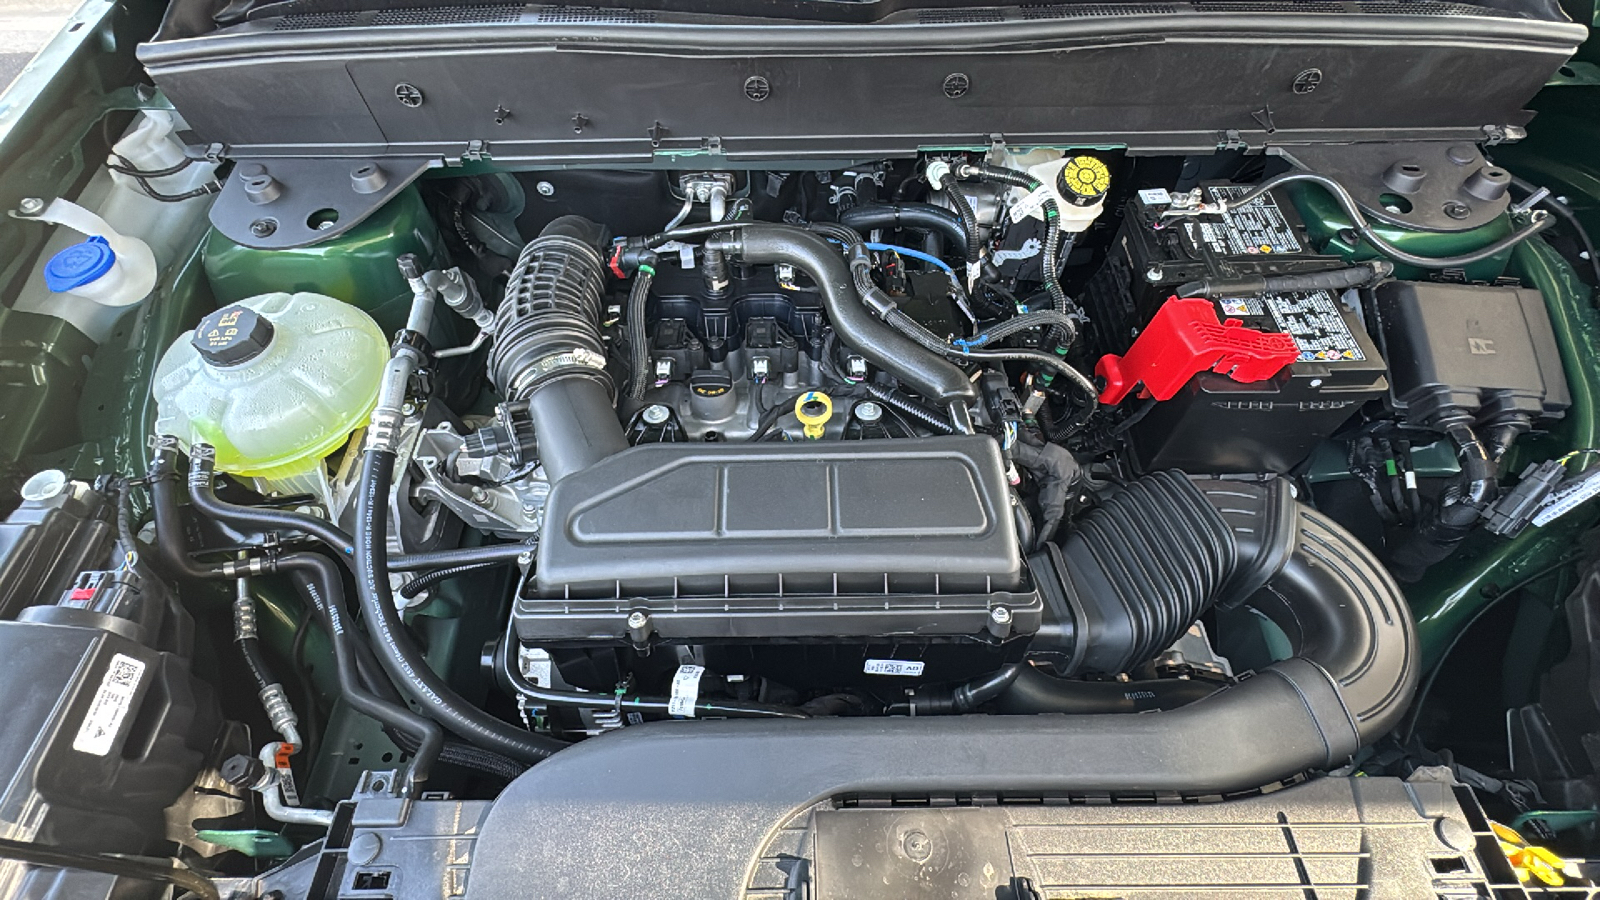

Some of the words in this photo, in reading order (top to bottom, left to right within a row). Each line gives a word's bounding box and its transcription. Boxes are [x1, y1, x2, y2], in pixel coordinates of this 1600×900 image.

[364, 531, 373, 549] HOSE
[366, 550, 374, 578] SUCTION
[367, 579, 376, 590] A/C
[412, 678, 442, 705] GALAXY
